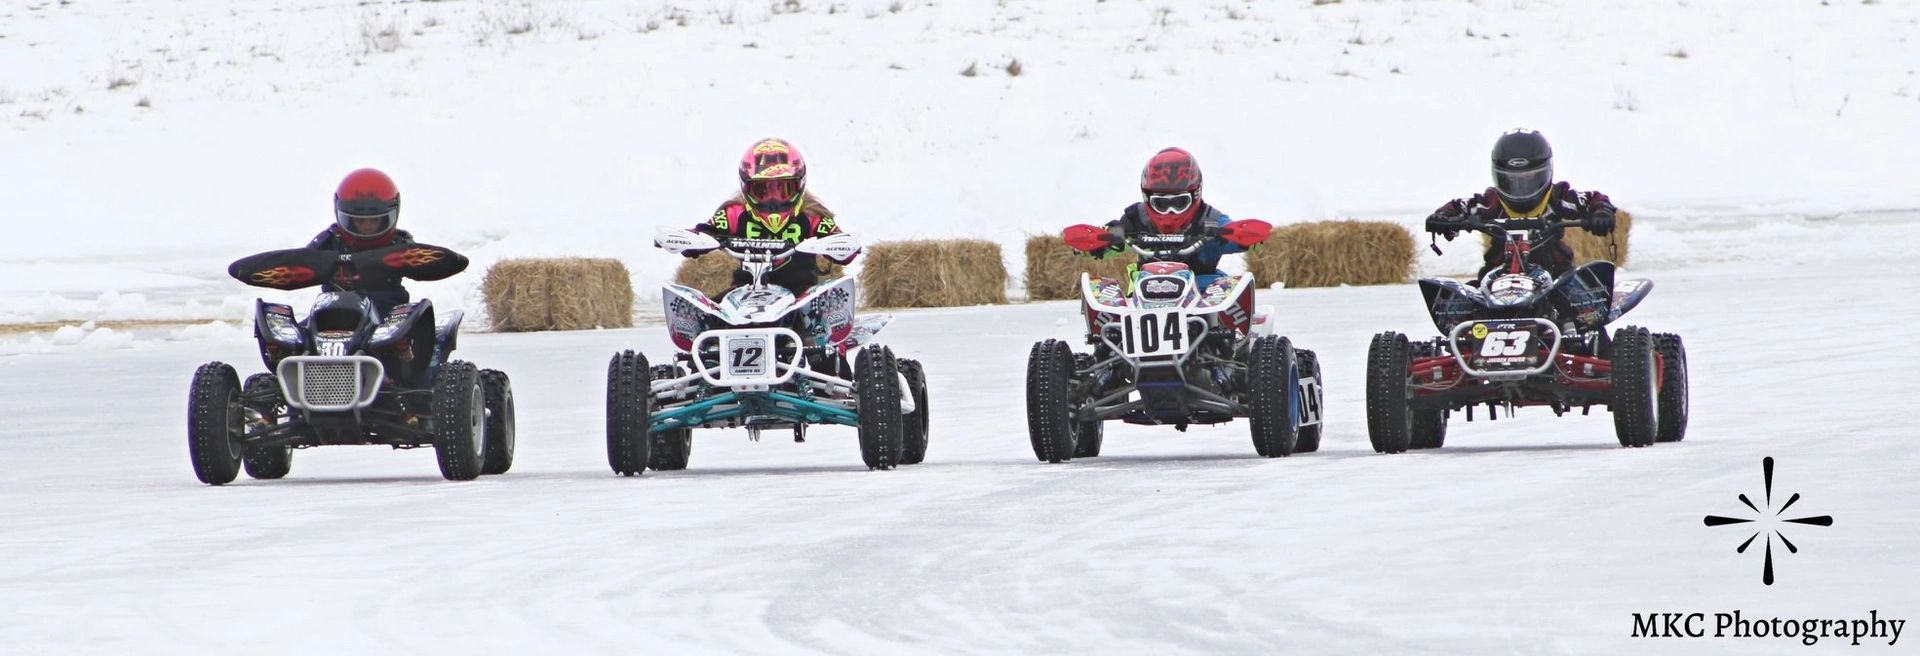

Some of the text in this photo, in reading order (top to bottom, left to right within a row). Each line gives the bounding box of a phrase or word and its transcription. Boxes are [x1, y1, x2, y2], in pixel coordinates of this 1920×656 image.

[746, 221, 801, 244] FR
[1124, 312, 1182, 354] 104
[1480, 331, 1531, 357] 63
[732, 347, 763, 367] 12
